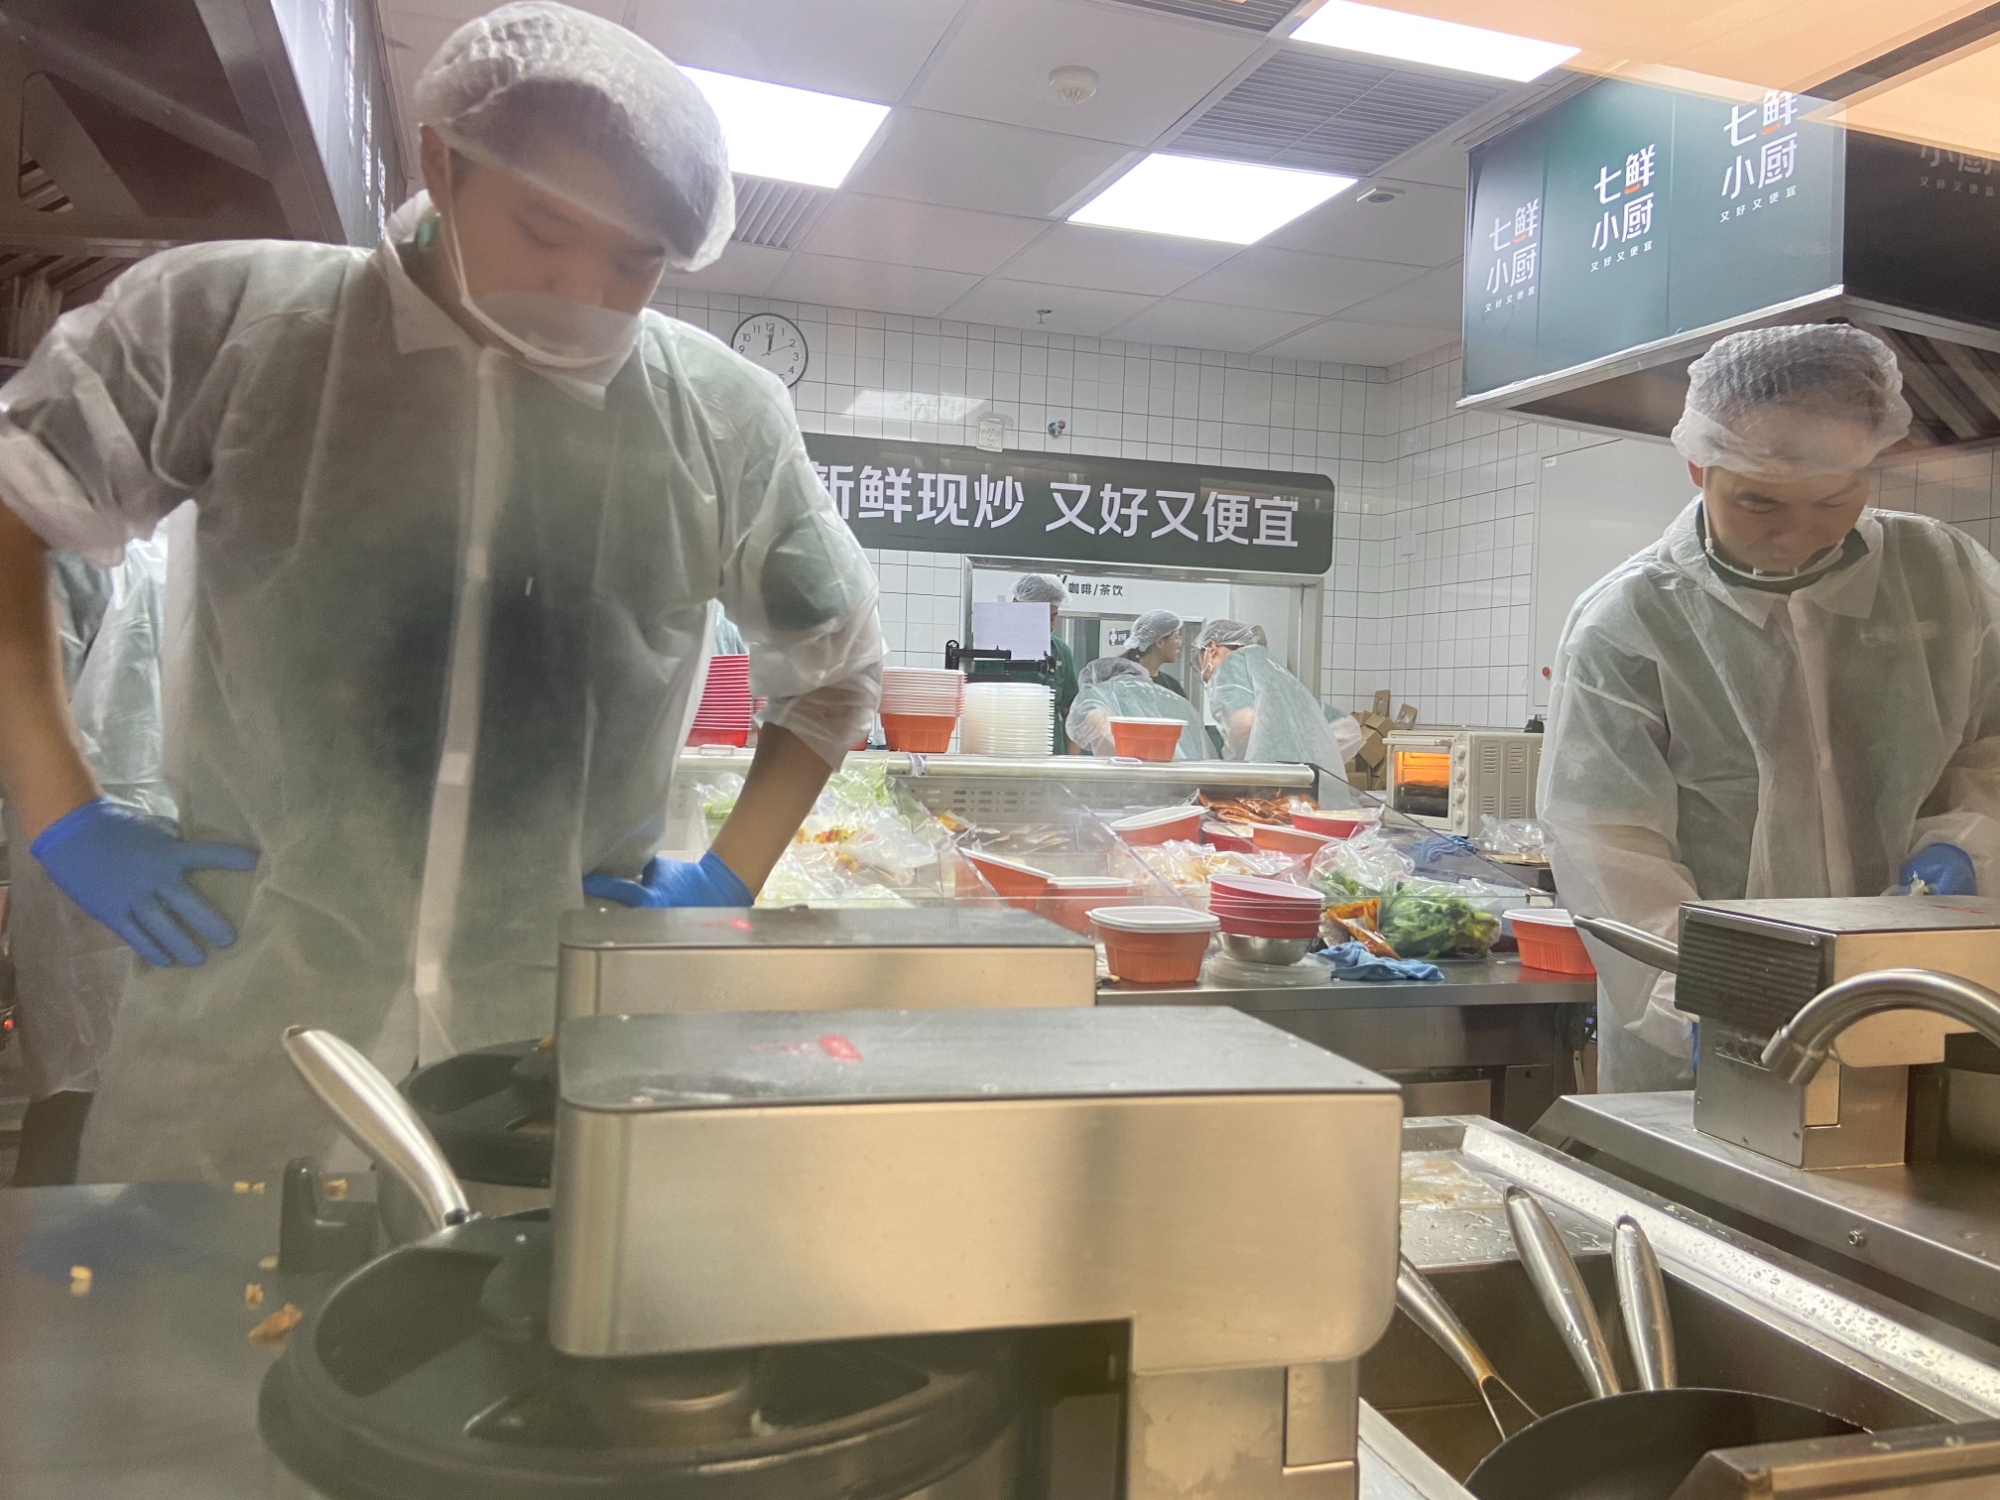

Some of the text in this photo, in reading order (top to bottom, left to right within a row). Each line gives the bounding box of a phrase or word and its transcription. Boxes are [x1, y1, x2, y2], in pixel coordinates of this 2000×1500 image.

[1723, 89, 1798, 147] 七鲜
[1593, 143, 1656, 205] 七鲜
[1721, 132, 1798, 200] 小厨
[1488, 198, 1539, 251] 七鲜
[1591, 192, 1654, 252] 小厨
[1719, 185, 1797, 223] 又好又便宜
[1486, 242, 1537, 294] 小厨
[789, 338, 796, 348] 2
[793, 352, 799, 361] 3
[1045, 481, 1299, 547] 又好又便宜
